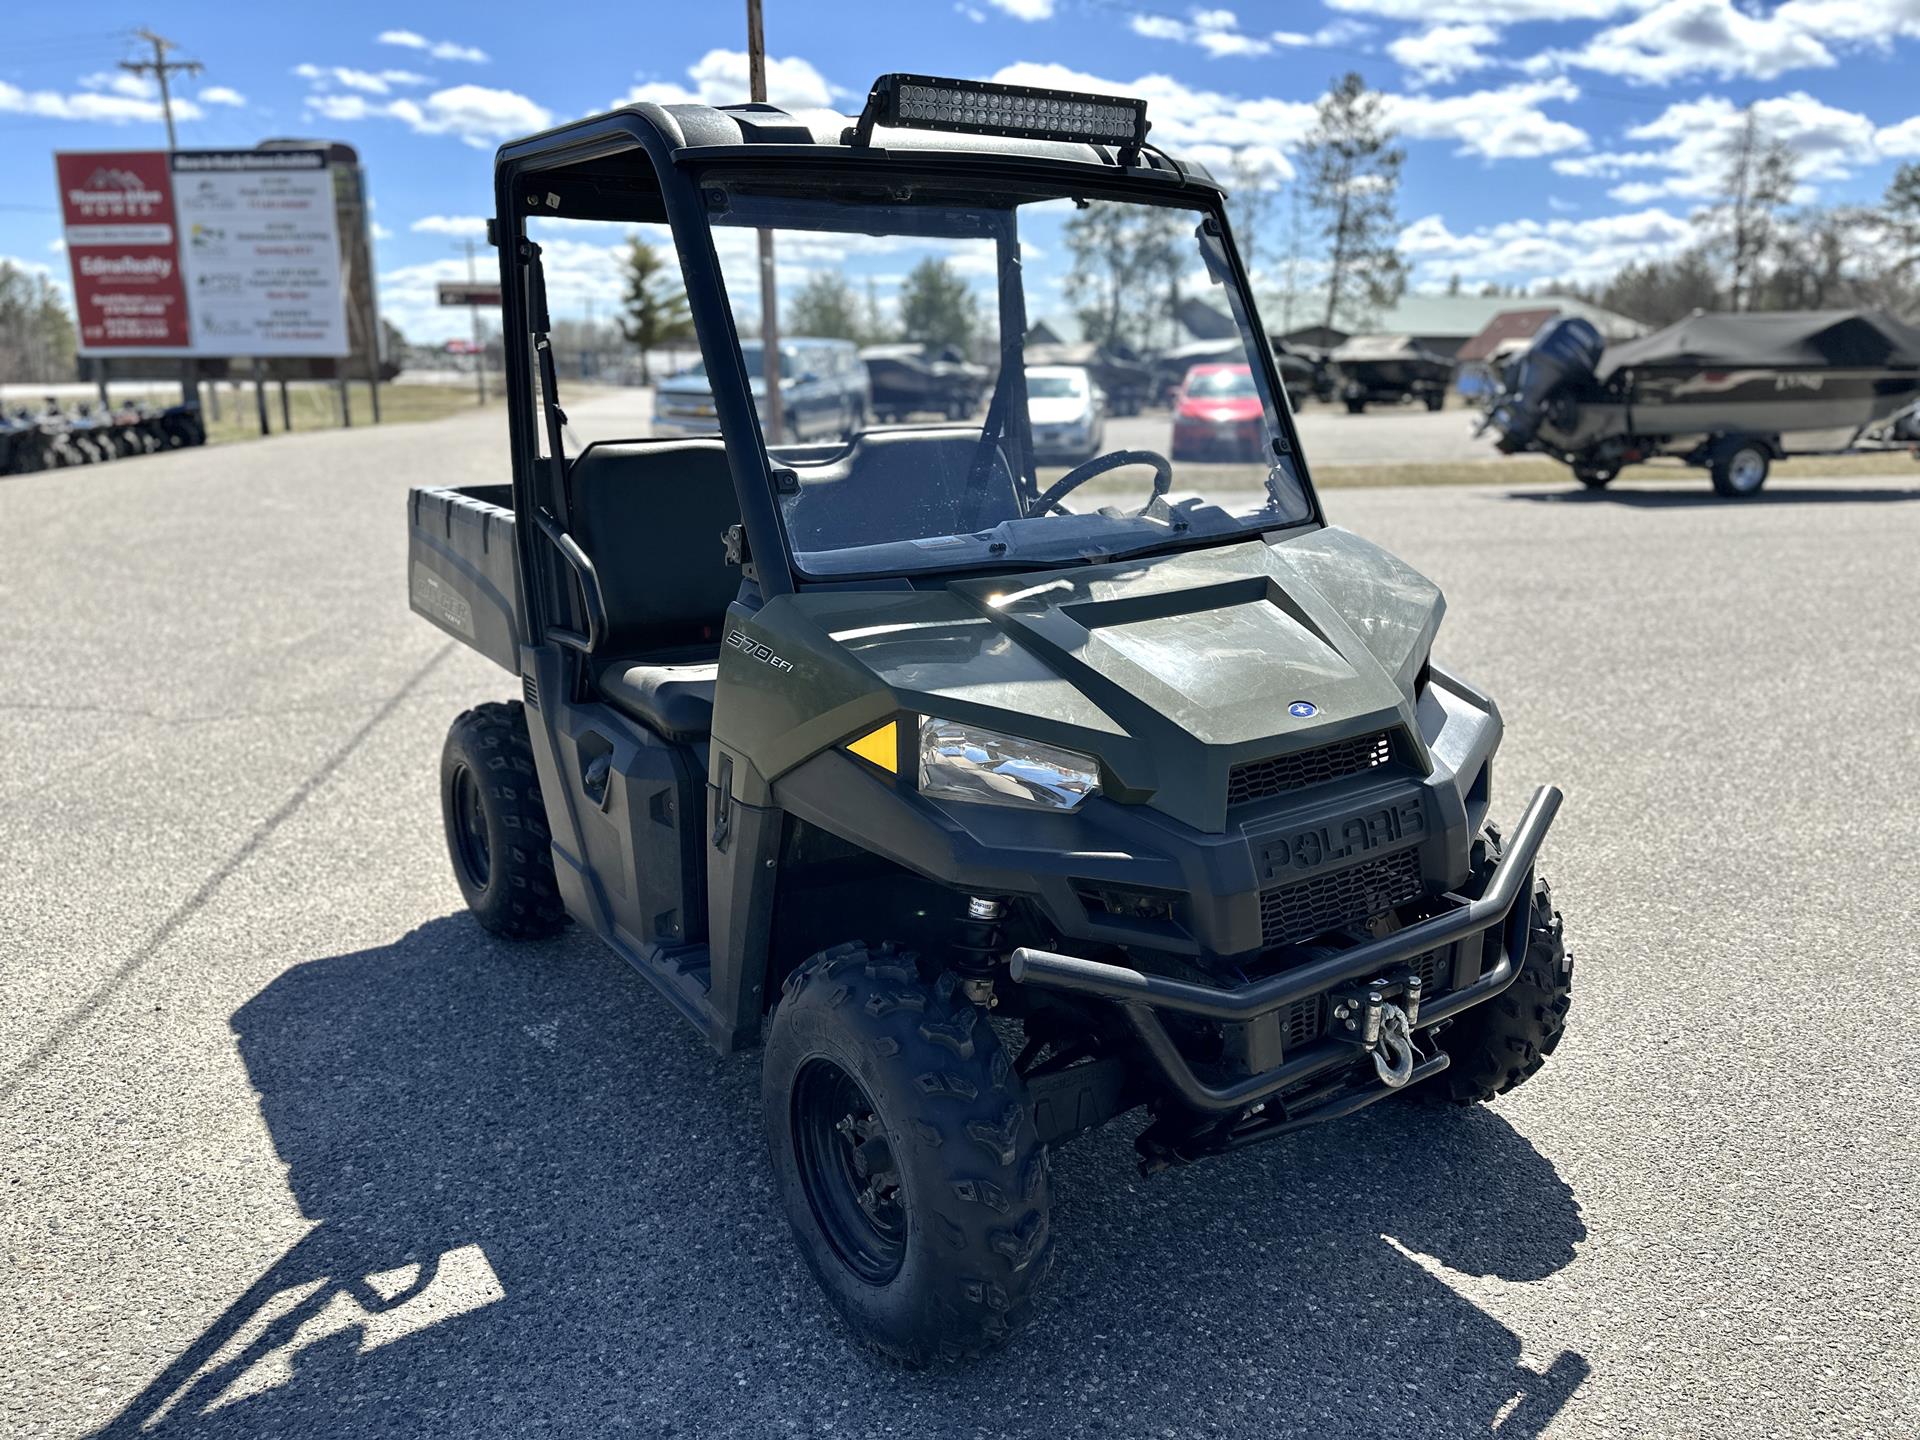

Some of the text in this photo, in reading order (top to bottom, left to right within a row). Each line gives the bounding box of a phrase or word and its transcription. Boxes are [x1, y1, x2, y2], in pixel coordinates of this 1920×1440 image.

[726, 629, 794, 673] 570 EFI
[1261, 798, 1425, 880] POLARIS
